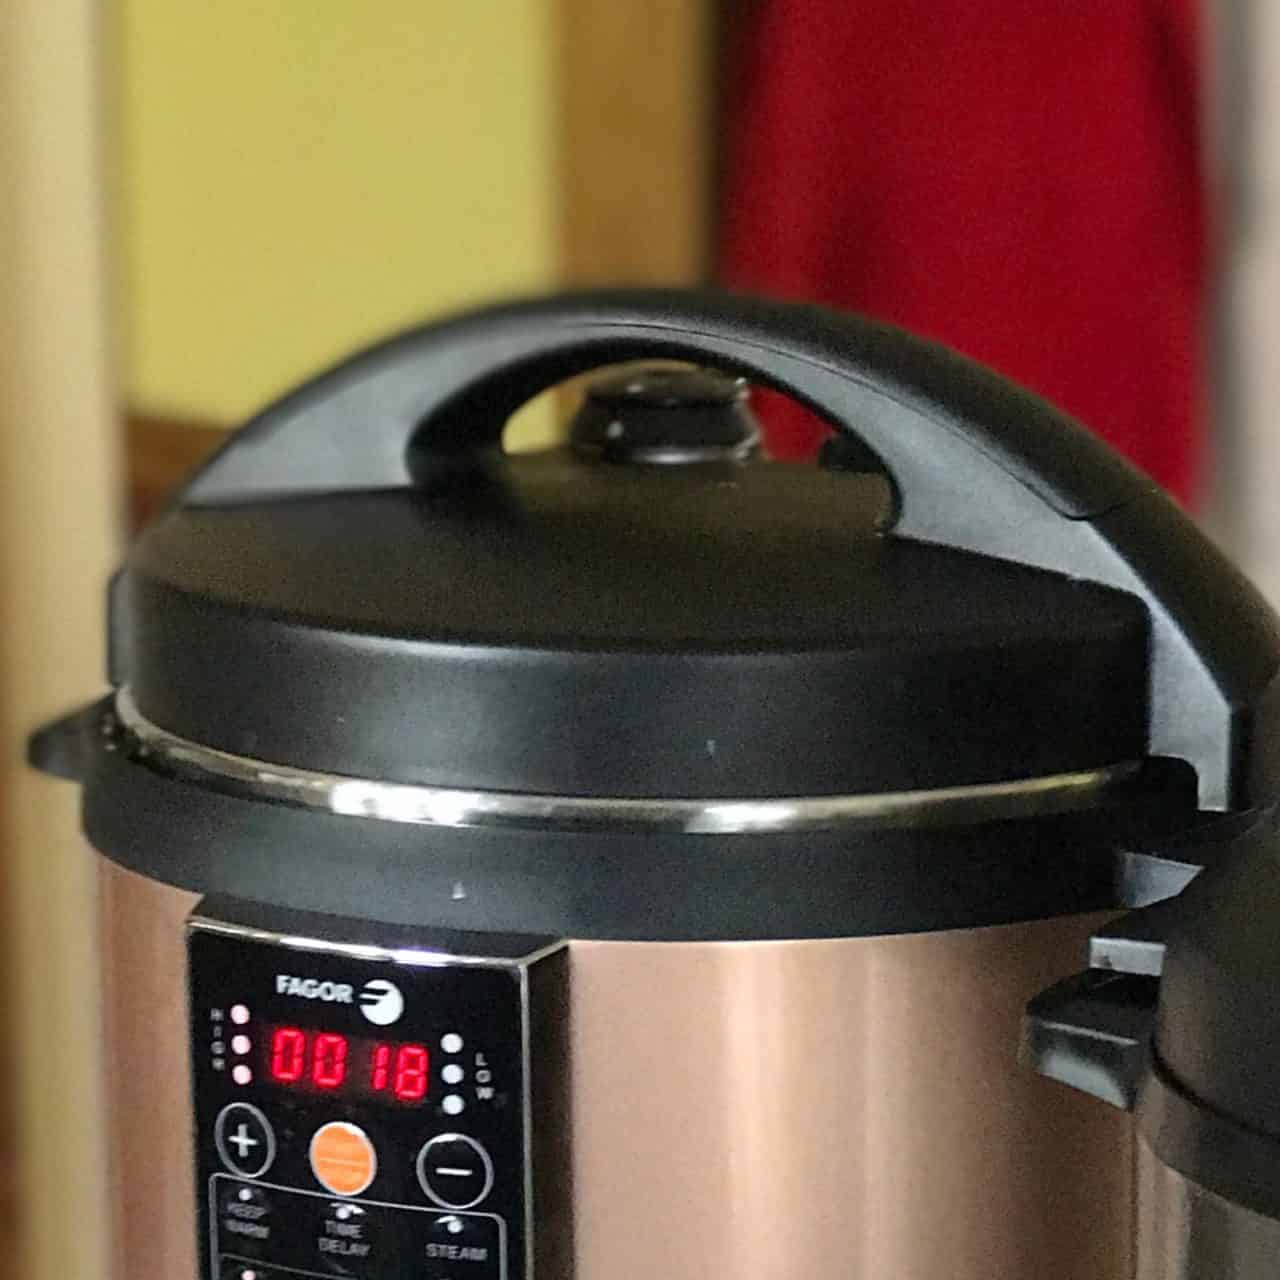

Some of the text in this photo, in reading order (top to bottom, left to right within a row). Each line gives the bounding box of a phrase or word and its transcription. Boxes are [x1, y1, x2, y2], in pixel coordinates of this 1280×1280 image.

[276, 974, 354, 1003] FAGOR
[474, 1052, 495, 1100] LOW
[317, 1237, 371, 1257] DELAY
[424, 1243, 488, 1261] STEAM
